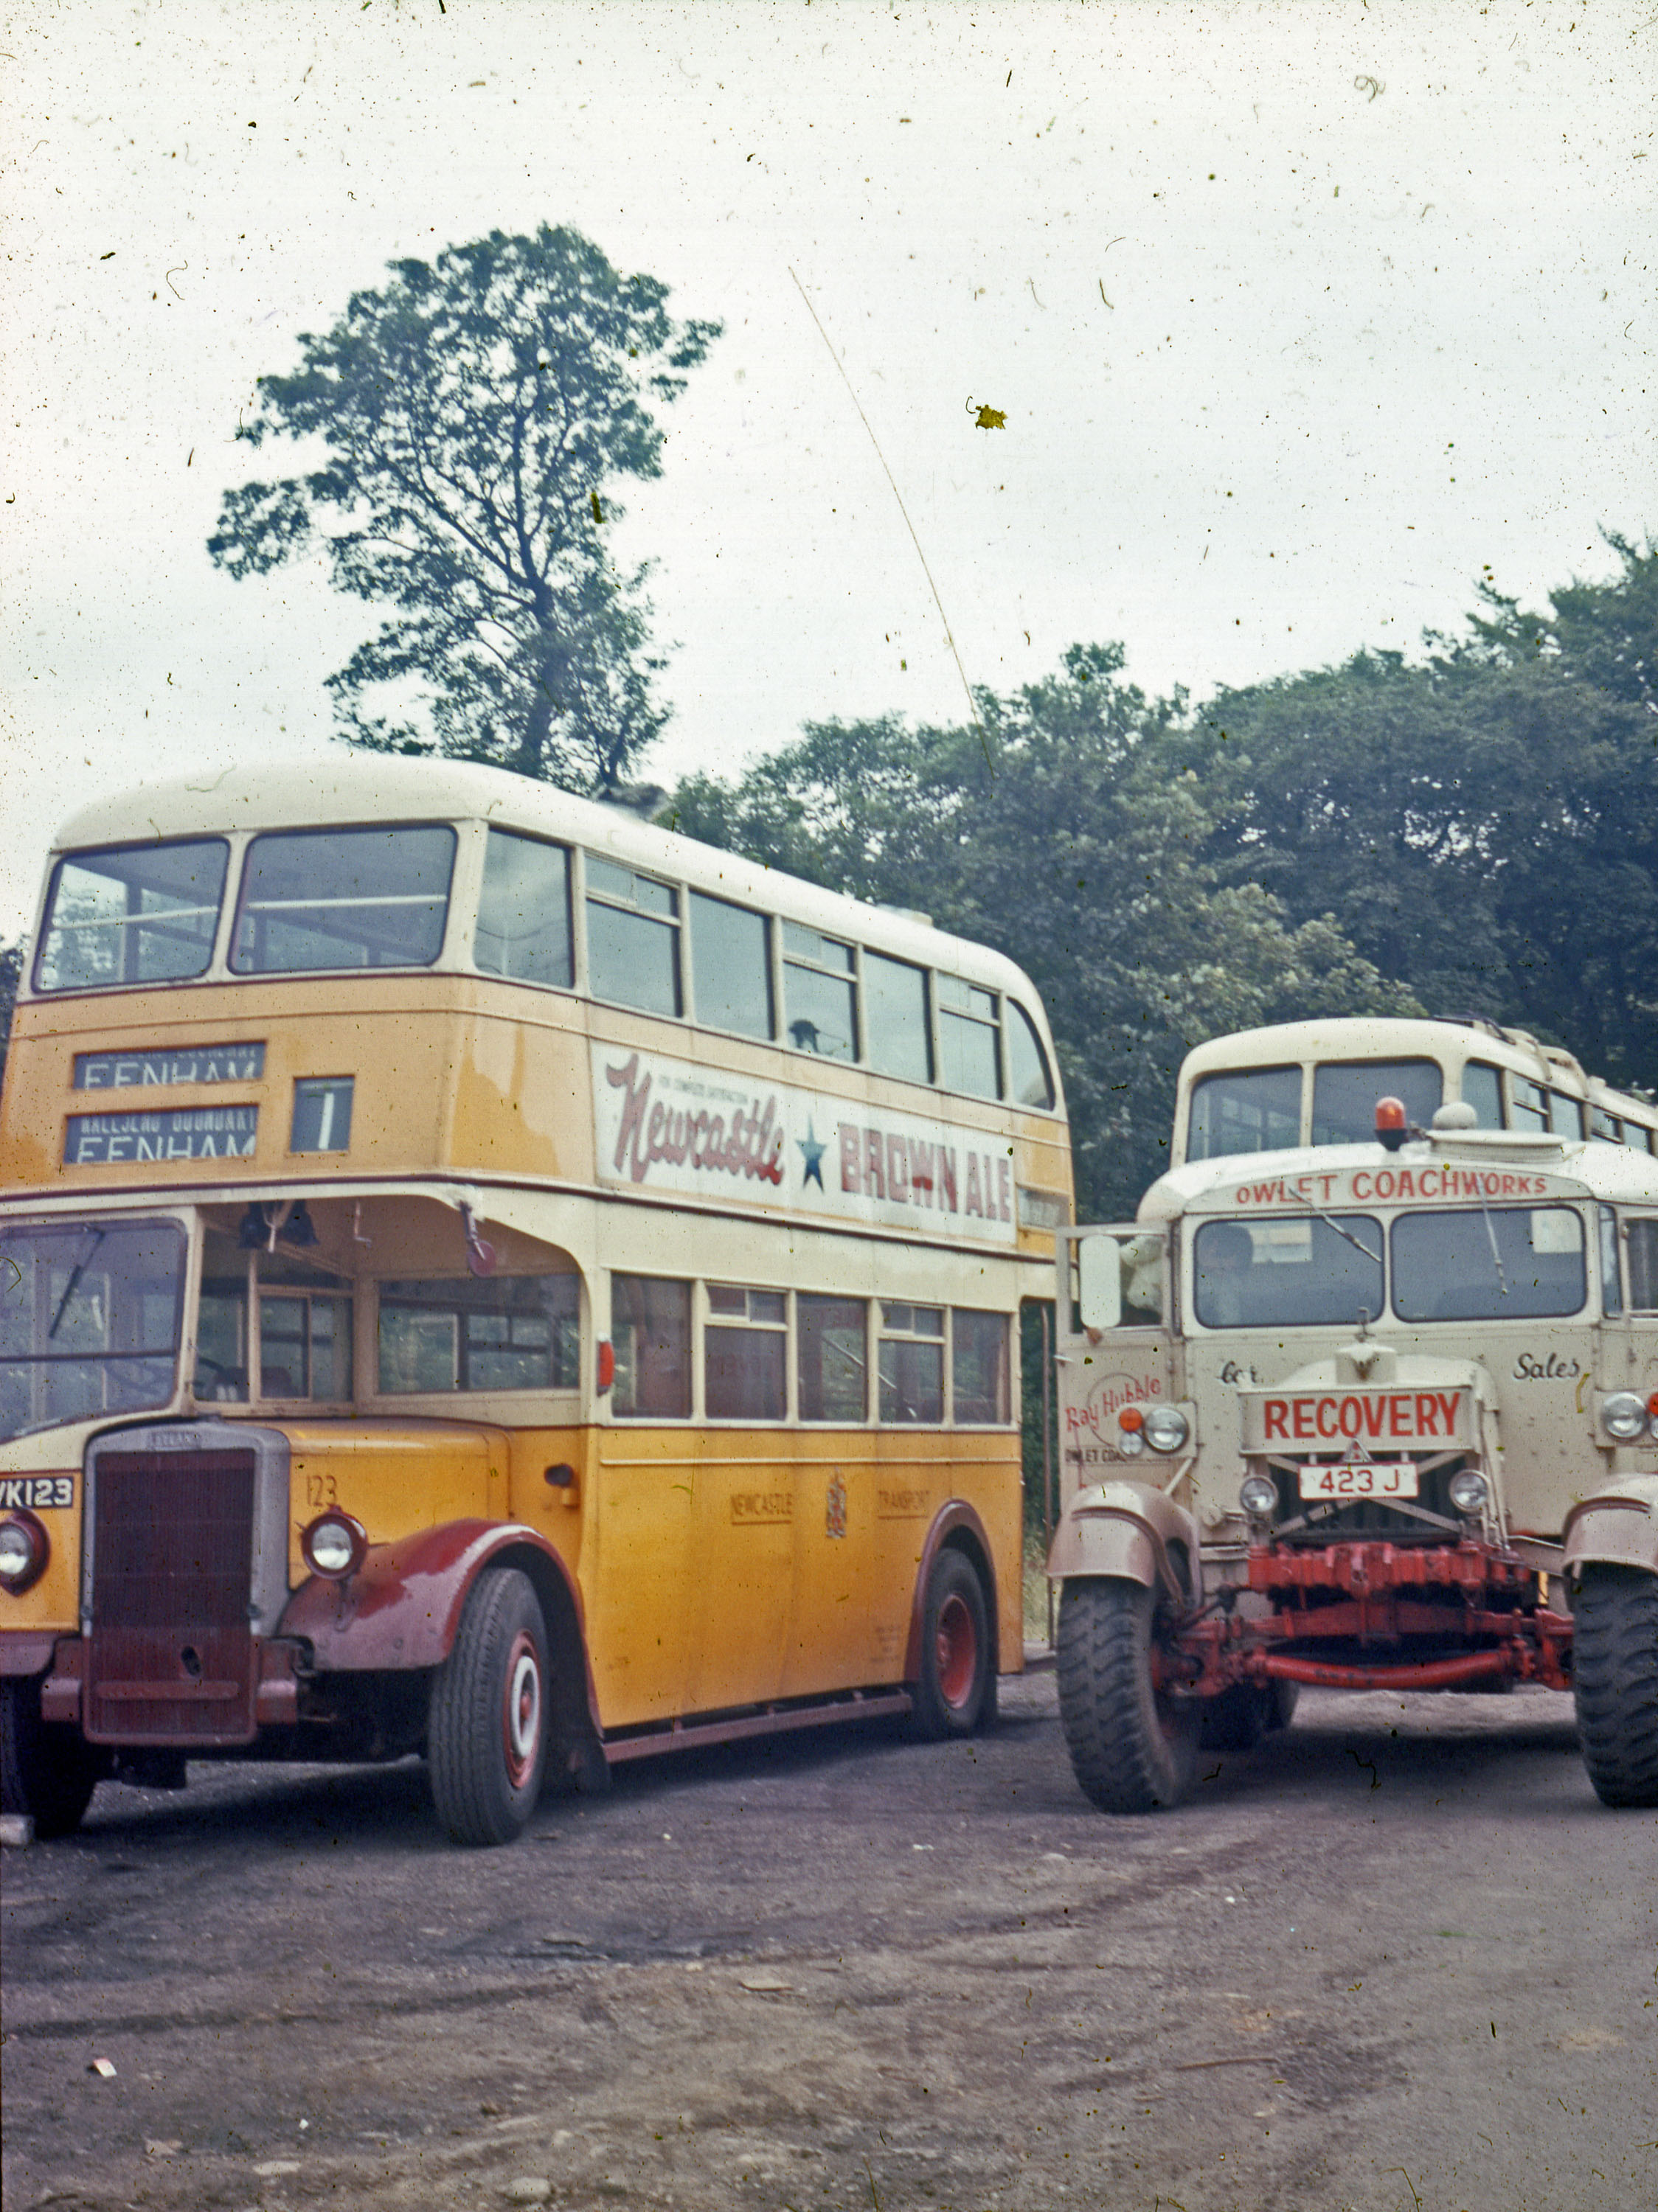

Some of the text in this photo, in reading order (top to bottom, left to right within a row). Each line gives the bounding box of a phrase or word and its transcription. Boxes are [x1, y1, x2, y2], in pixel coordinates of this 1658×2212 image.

[84, 1060, 256, 1090] FENHAM
[318, 1092, 335, 1150] 1
[606, 1053, 785, 1186] Newcastle
[77, 1133, 256, 1164] FENHAM
[838, 1121, 1011, 1223] BROWN ALE
[1236, 1169, 1547, 1205] OWLET COACHWORKS
[1513, 1352, 1581, 1380] Sales
[1065, 1374, 1162, 1432] Ray Hubble
[1263, 1391, 1460, 1439] RECOVERY
[306, 1475, 337, 1508] 123
[1319, 1469, 1400, 1492] 423 J
